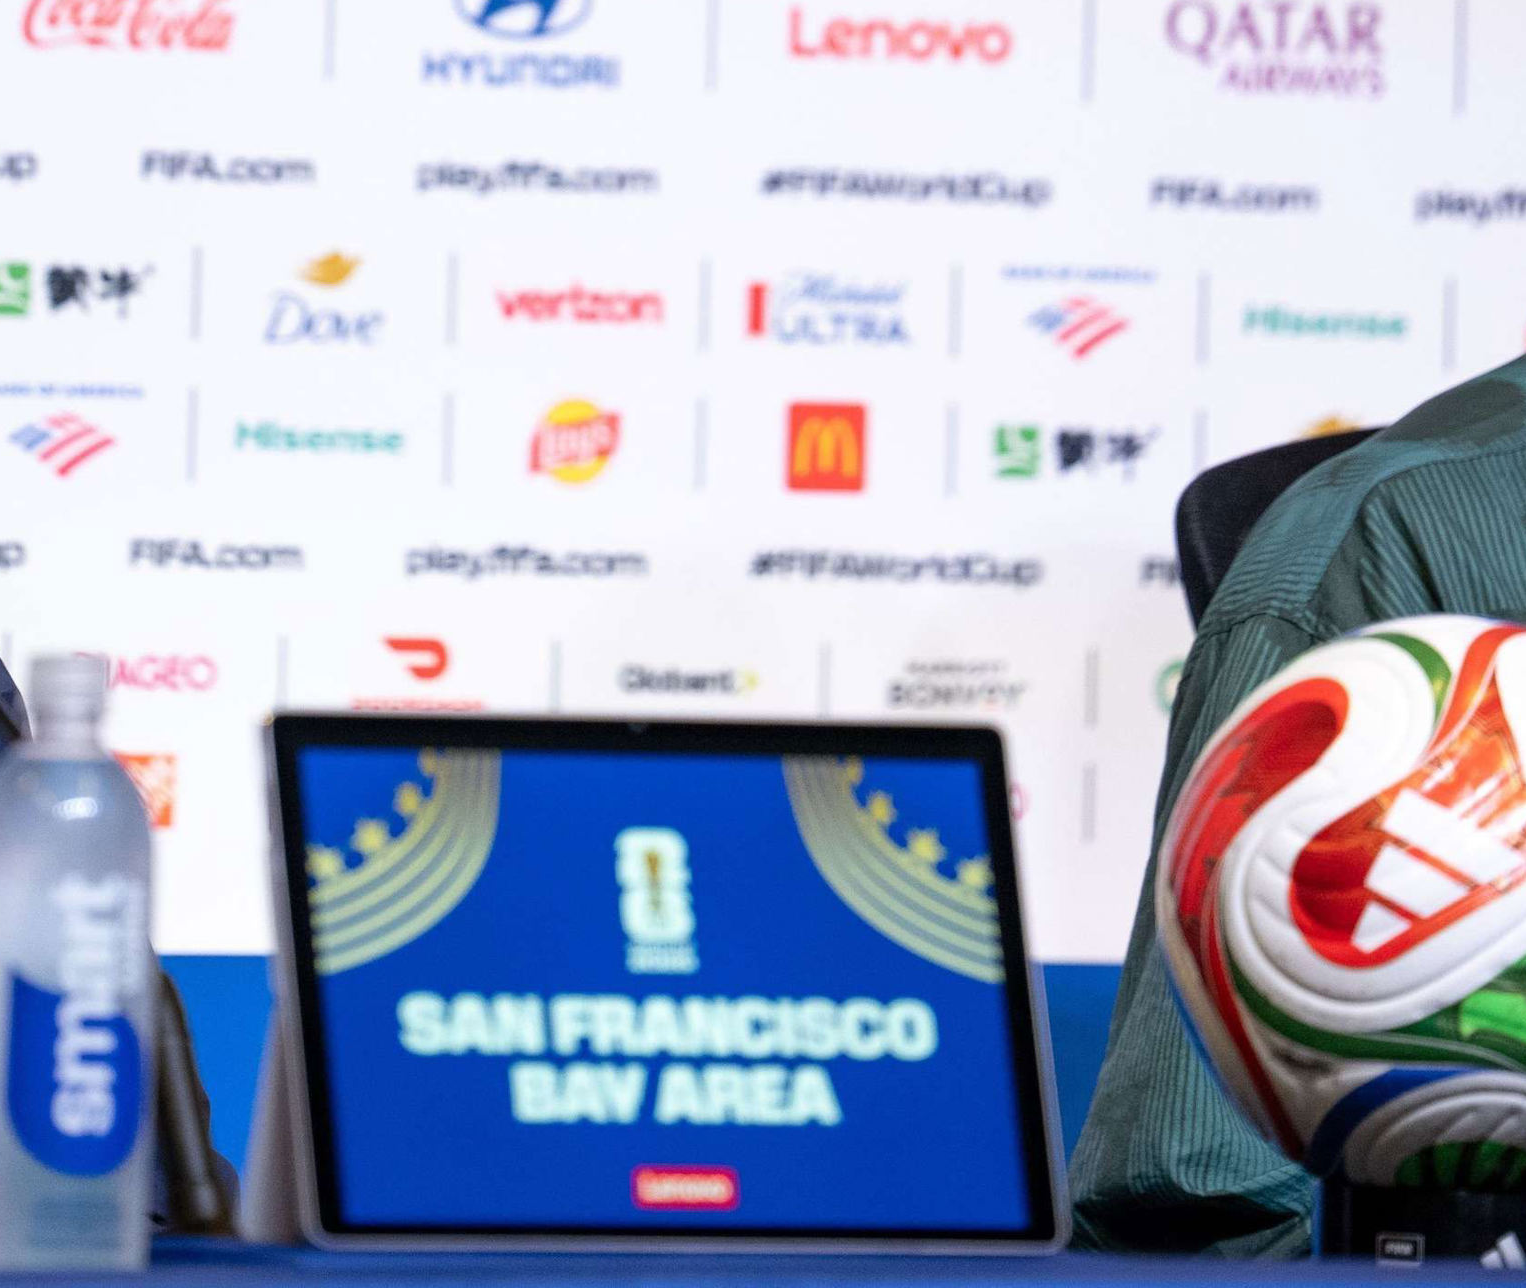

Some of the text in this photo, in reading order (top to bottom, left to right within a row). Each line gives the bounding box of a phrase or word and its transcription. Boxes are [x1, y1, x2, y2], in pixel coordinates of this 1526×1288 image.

[788, 6, 1014, 65] Lenovo
[421, 52, 620, 89] HYUNDAI
[140, 150, 315, 184] FIFA.com
[1150, 177, 1319, 212] FIFA.com
[497, 285, 663, 324] verizon
[234, 421, 404, 455] Hisense
[129, 537, 303, 570] FIFA.com
[50, 878, 121, 1140] smart
[397, 992, 939, 1062] SAN FRANCISCO
[509, 1062, 844, 1128] BAY AREA
